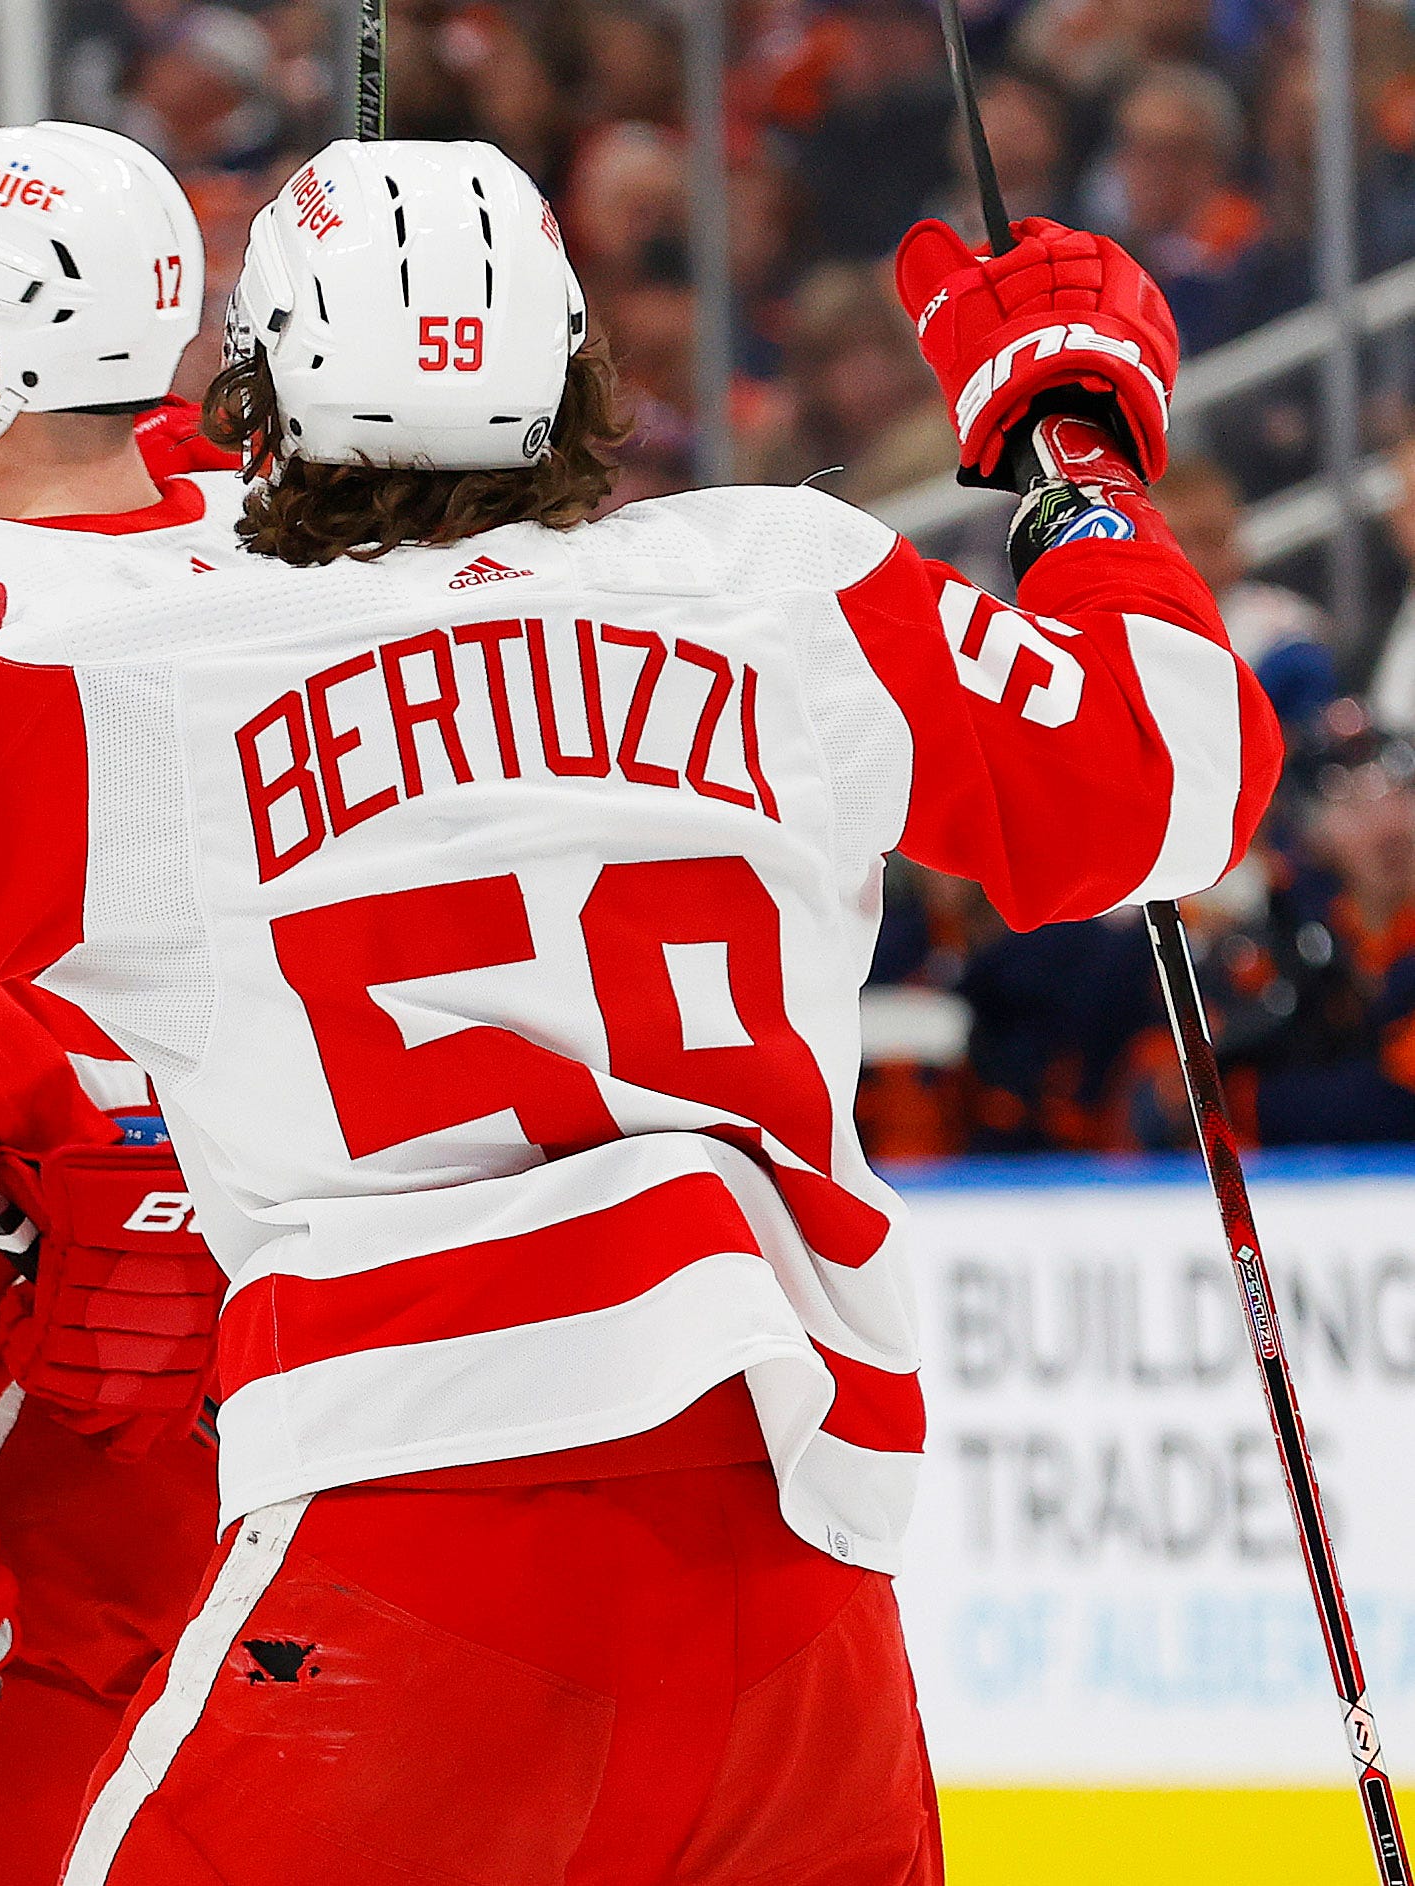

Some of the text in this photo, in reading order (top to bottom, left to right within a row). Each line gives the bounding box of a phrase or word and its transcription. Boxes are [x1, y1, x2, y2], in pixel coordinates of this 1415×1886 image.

[290, 165, 343, 242] meijer
[153, 255, 182, 310] 17
[418, 316, 484, 372] 59
[448, 570, 535, 590] adidas
[938, 579, 1086, 729] 5
[235, 618, 781, 885] BERTUZZI
[270, 855, 891, 1269] 59
[946, 1254, 1415, 1390] BUILDNG
